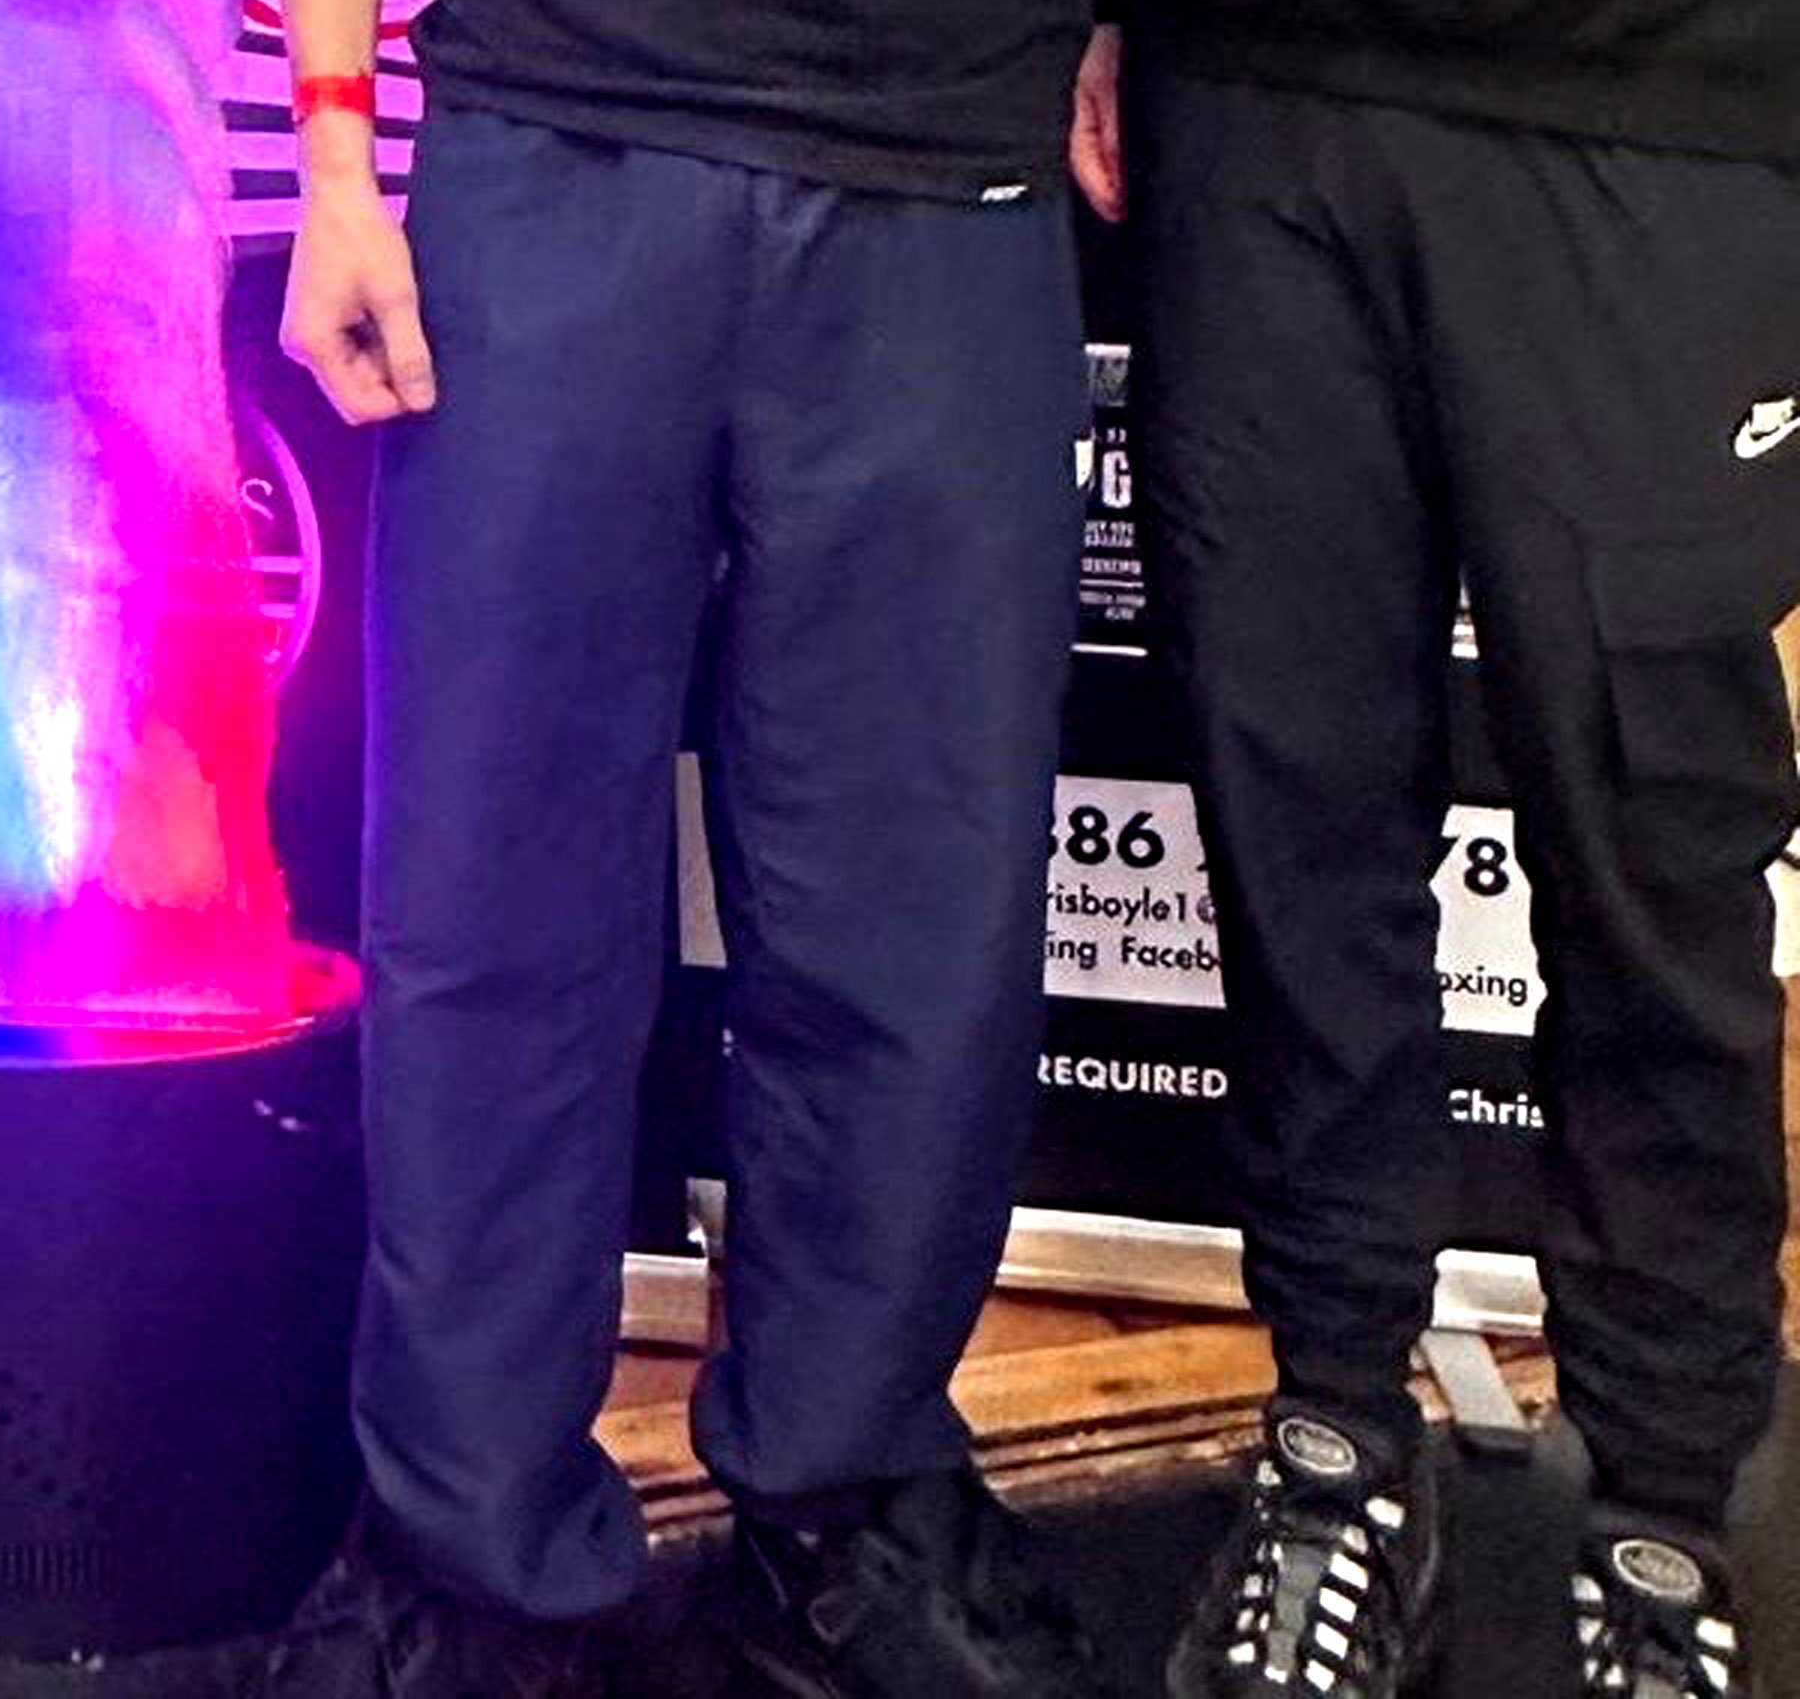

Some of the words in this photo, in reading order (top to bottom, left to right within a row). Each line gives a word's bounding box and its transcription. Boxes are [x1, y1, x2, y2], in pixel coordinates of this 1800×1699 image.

[1050, 805, 1165, 869] 86
[1121, 936, 1222, 972] Faceb
[1439, 965, 1528, 1007] oxing
[1037, 1052, 1228, 1099] REQUIRED
